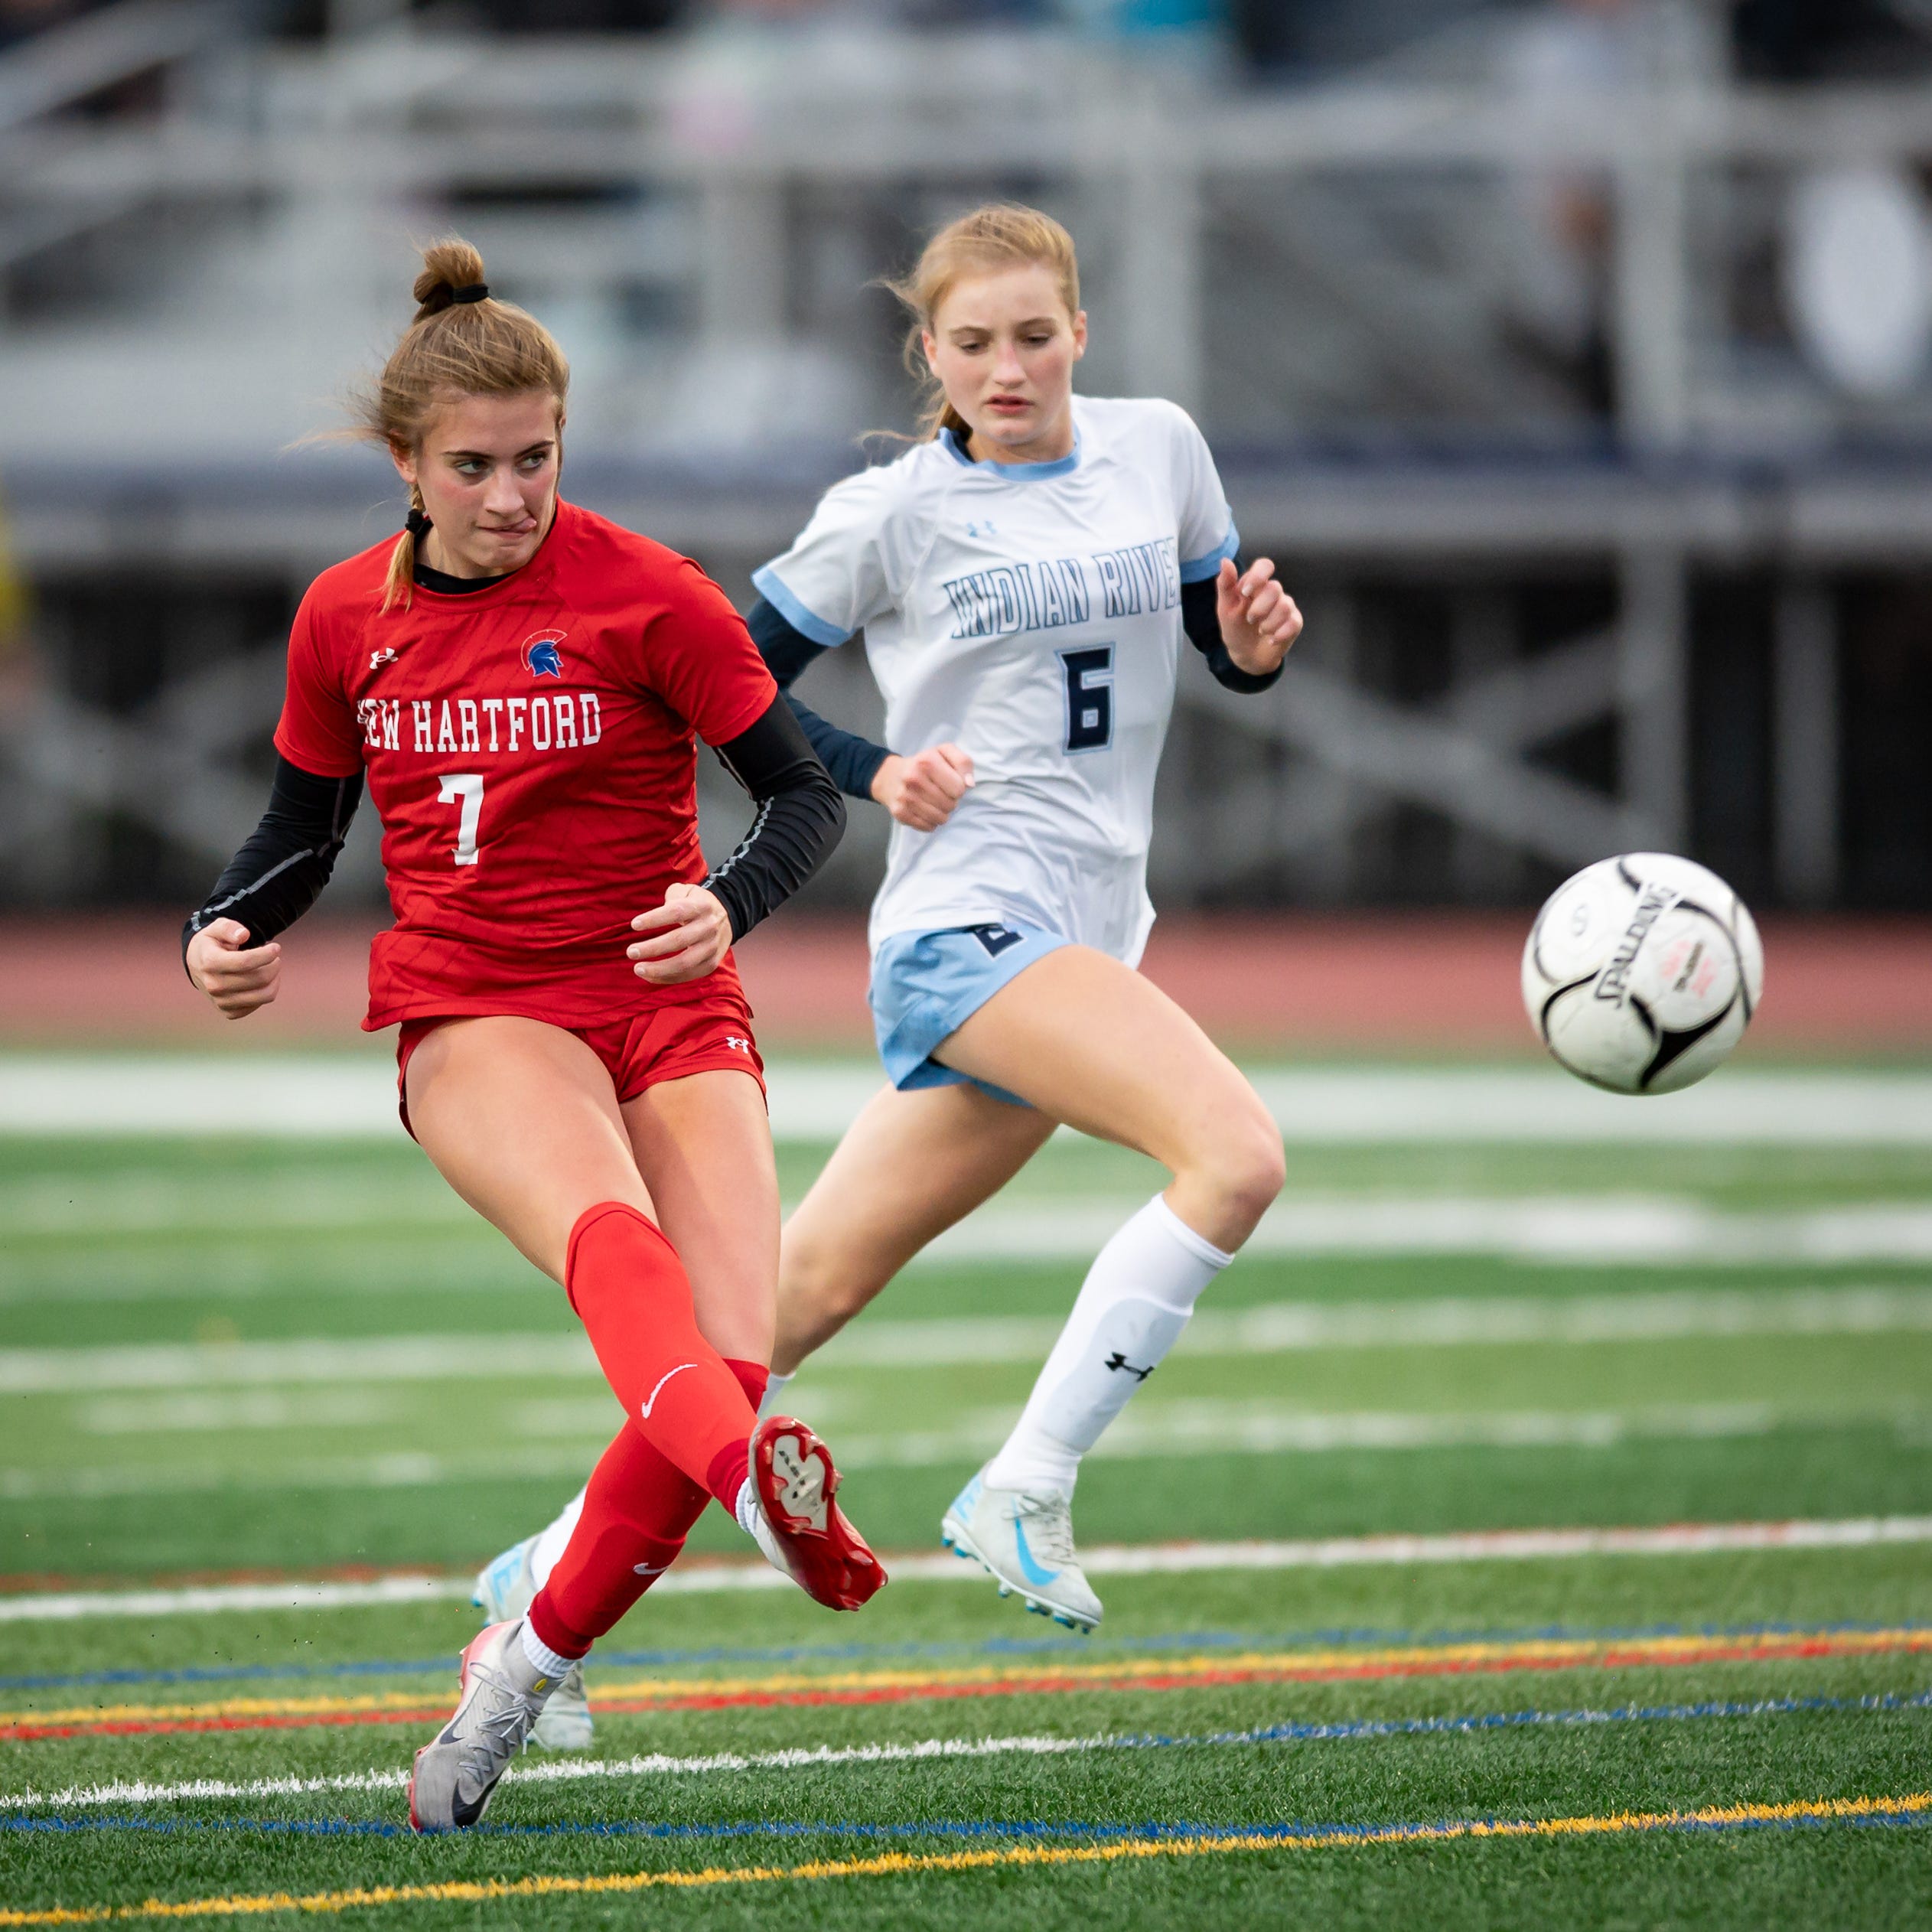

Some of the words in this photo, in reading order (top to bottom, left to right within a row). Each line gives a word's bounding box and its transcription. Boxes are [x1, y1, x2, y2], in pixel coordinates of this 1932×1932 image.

[943, 559, 1090, 639] INDIAN
[1091, 536, 1181, 617] RIVE
[412, 693, 601, 752] HARTFORD
[1055, 642, 1116, 756] 6
[437, 774, 484, 865] 7
